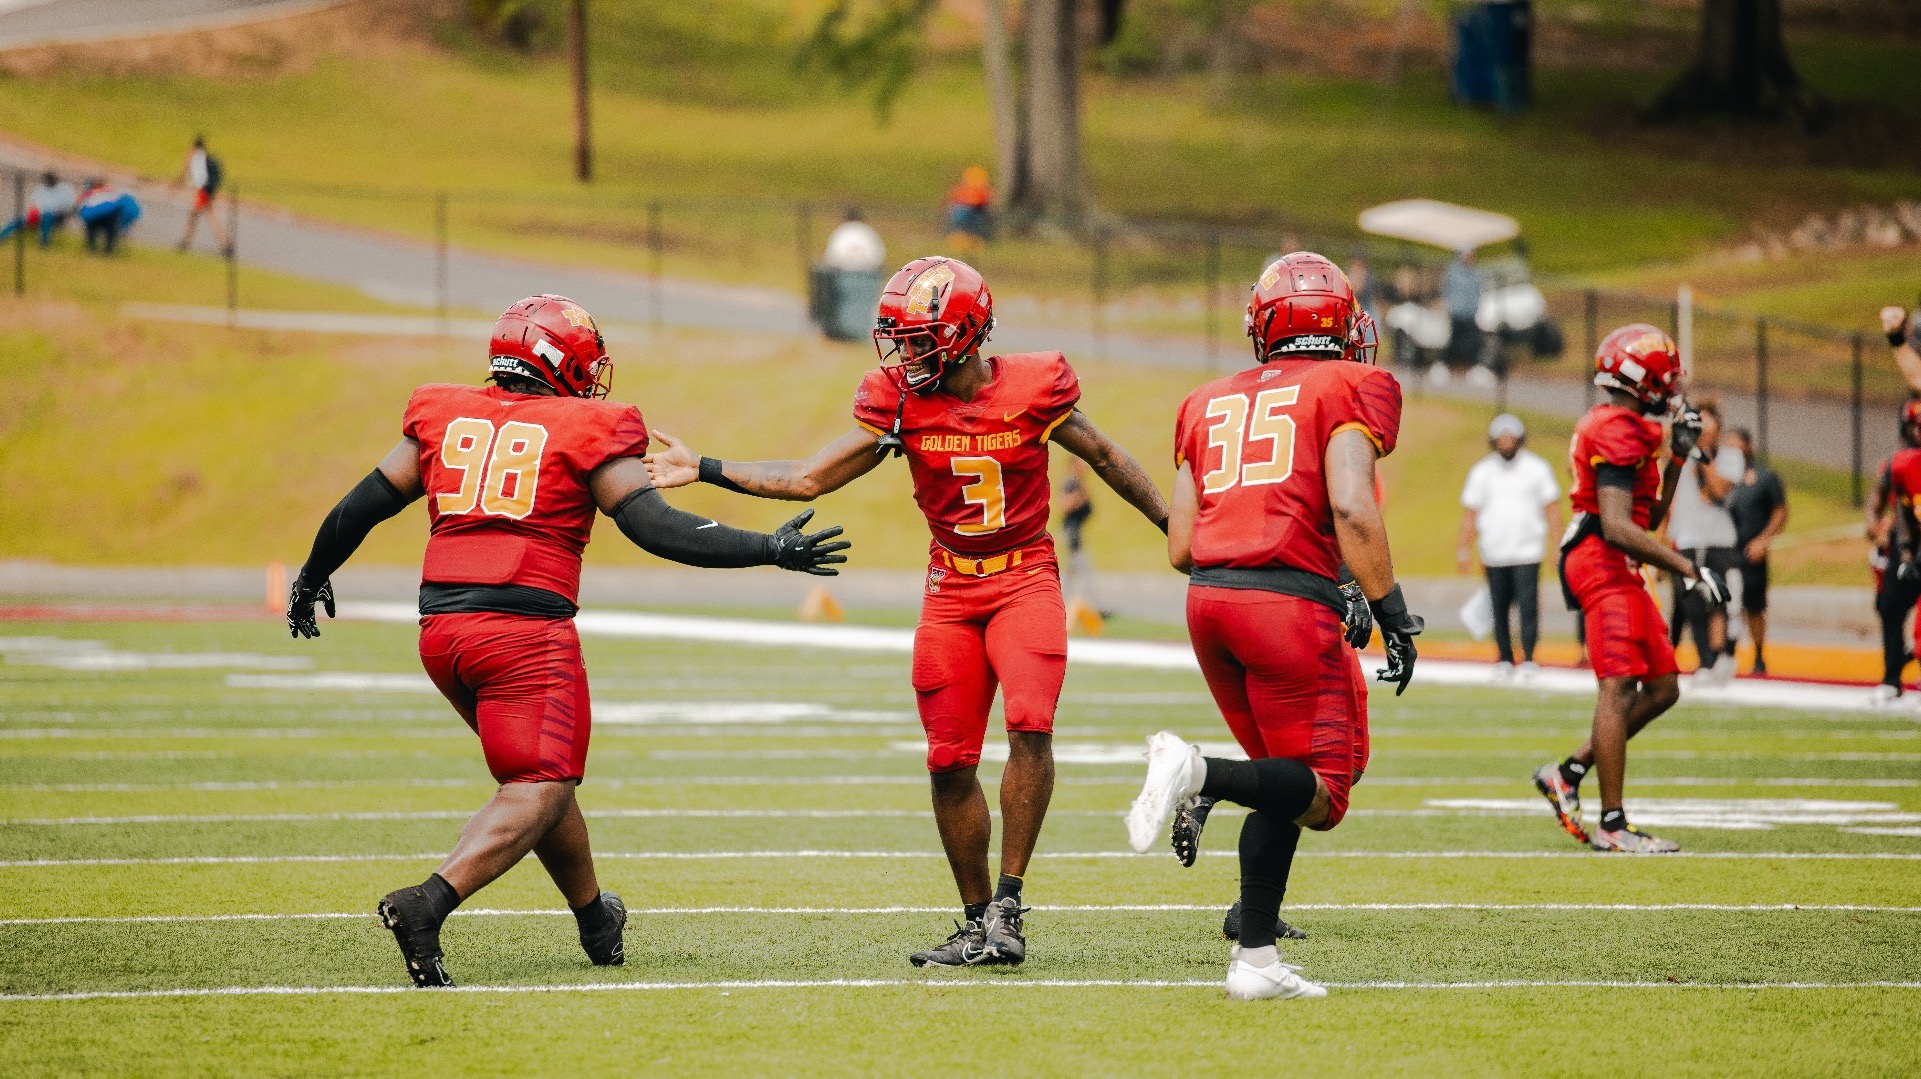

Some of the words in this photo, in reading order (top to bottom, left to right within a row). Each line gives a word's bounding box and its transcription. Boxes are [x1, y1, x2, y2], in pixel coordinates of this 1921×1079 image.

[1294, 334, 1332, 346] schutt
[1320, 317, 1334, 328] 35
[920, 435, 971, 452] GOLDEN
[975, 429, 1021, 452] TIGERS
[1203, 384, 1301, 495] 35
[436, 416, 548, 520] 98
[950, 455, 1006, 536] 3
